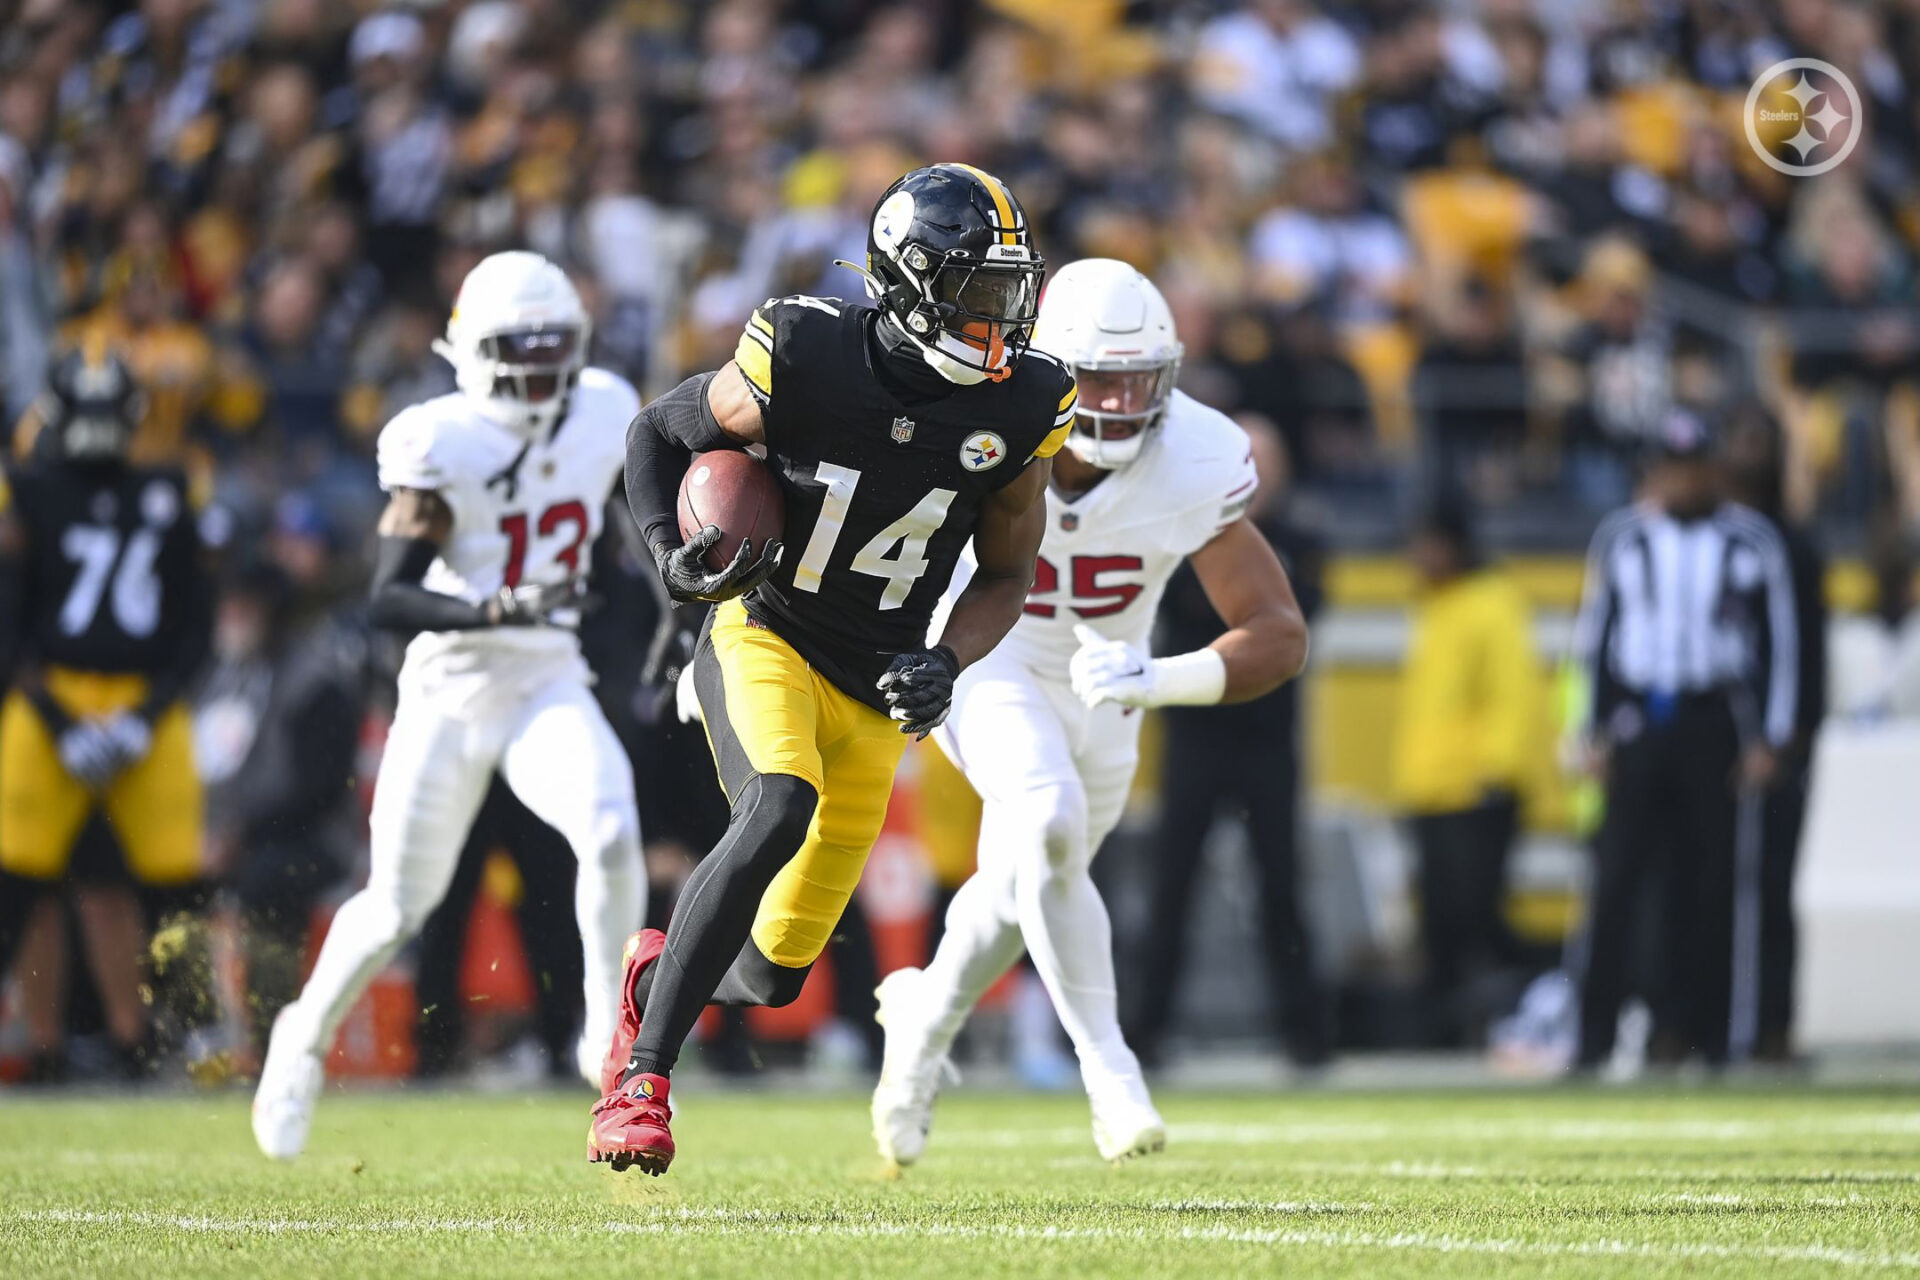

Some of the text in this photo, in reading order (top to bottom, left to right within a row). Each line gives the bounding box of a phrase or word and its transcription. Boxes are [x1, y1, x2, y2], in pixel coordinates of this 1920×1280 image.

[1000, 247, 1023, 258] Steelers
[894, 427, 910, 439] NFL
[59, 523, 162, 639] 76
[500, 500, 588, 591] 13
[792, 461, 958, 611] 14
